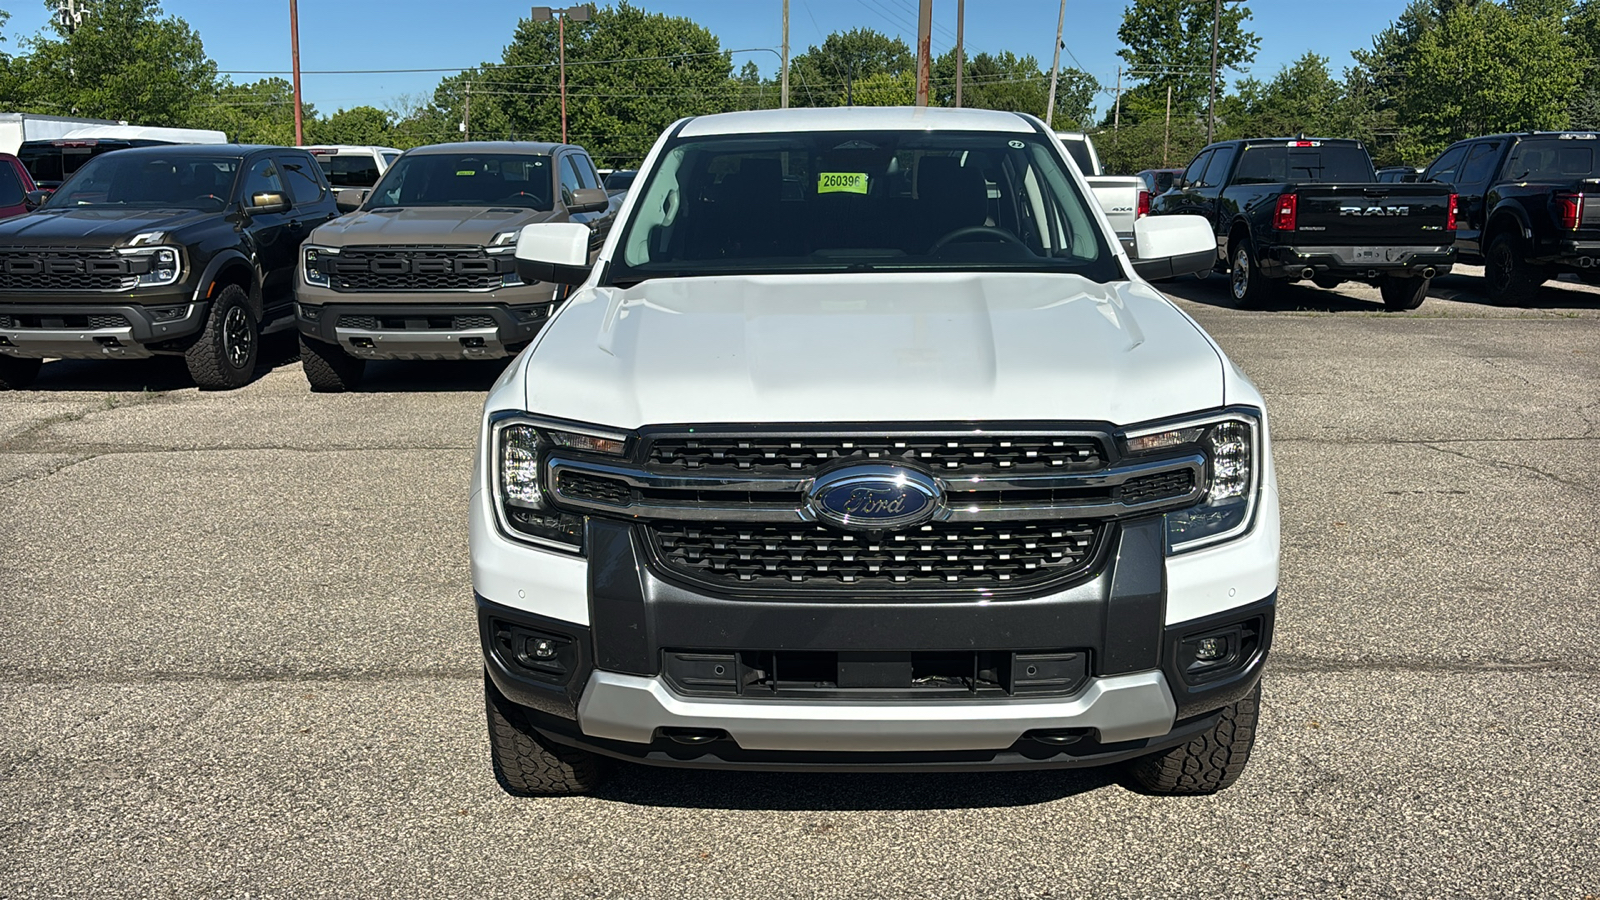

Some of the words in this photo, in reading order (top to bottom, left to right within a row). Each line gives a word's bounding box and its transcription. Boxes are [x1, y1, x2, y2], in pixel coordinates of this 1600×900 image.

[823, 175, 861, 187] 260396
[1339, 206, 1409, 216] RAM
[0, 259, 129, 275] ORD
[327, 258, 496, 274] FORD
[843, 487, 906, 514] Ford
